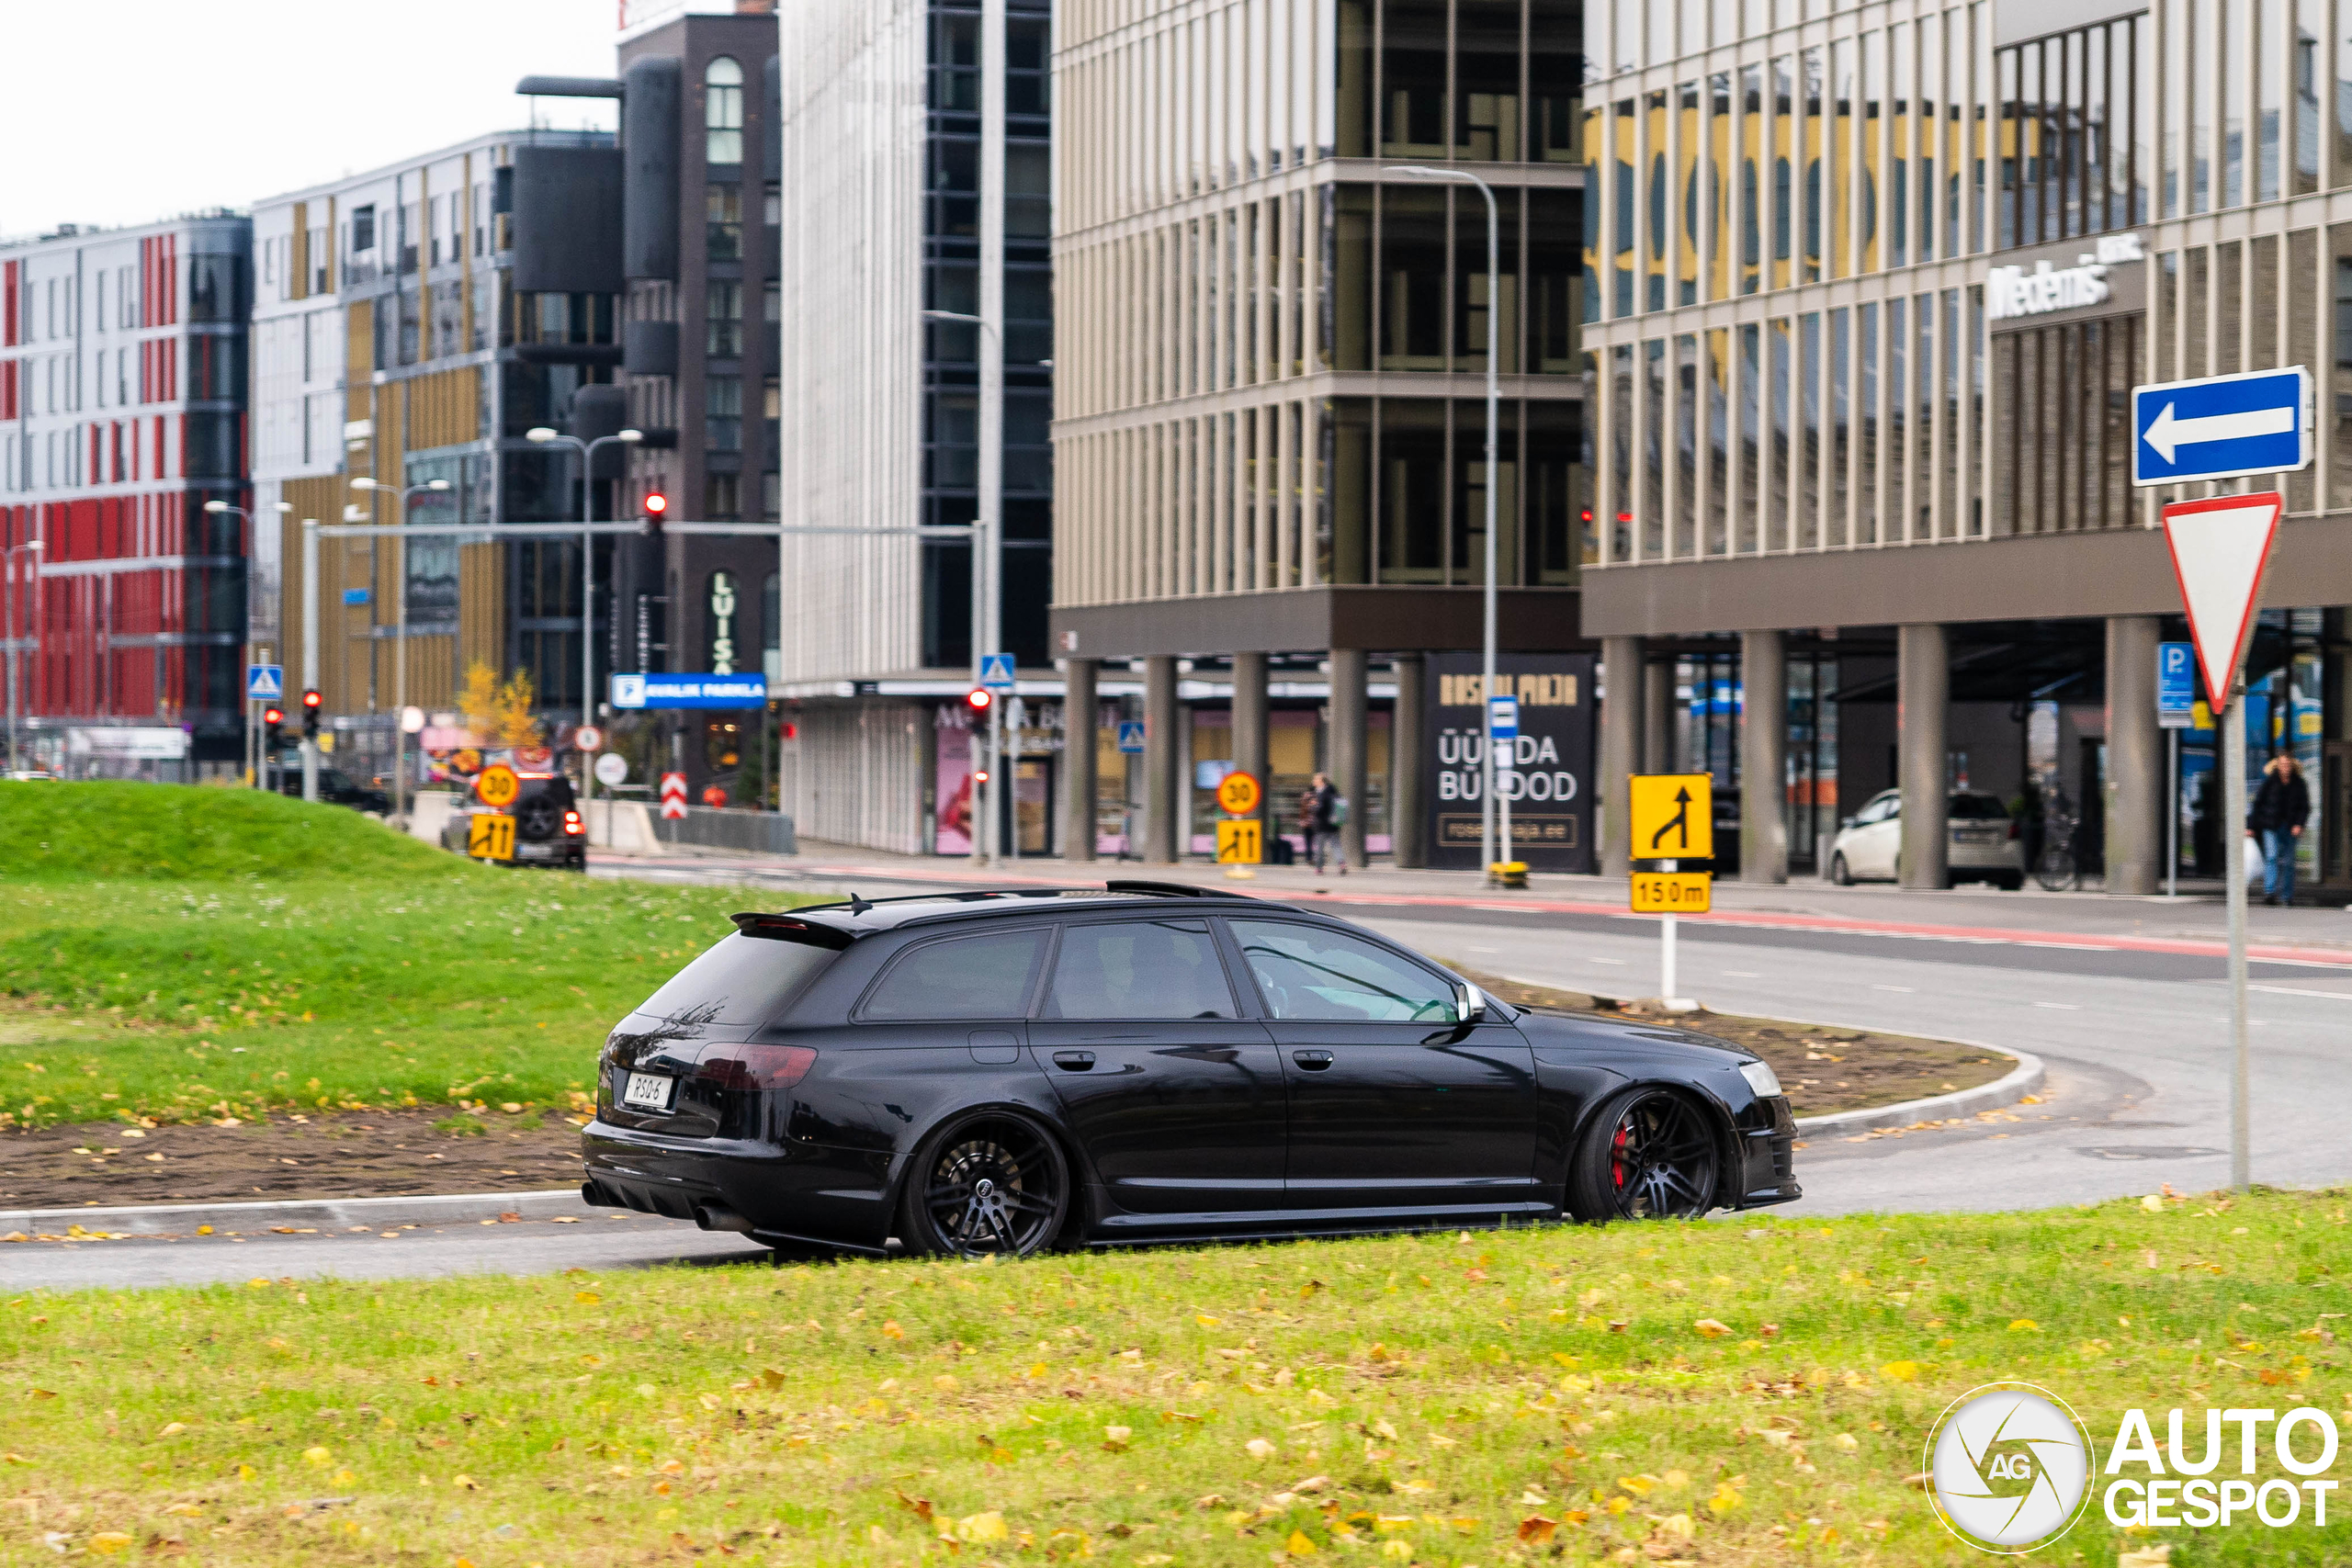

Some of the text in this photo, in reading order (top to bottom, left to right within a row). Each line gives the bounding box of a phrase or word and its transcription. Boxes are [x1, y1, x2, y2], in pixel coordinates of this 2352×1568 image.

[712, 571, 734, 675] LUISA
[1438, 728, 1559, 764] ÜÜDA
[486, 775, 511, 796] 30
[1229, 784, 1250, 803] 30
[1439, 763, 1577, 801] BÜOOD
